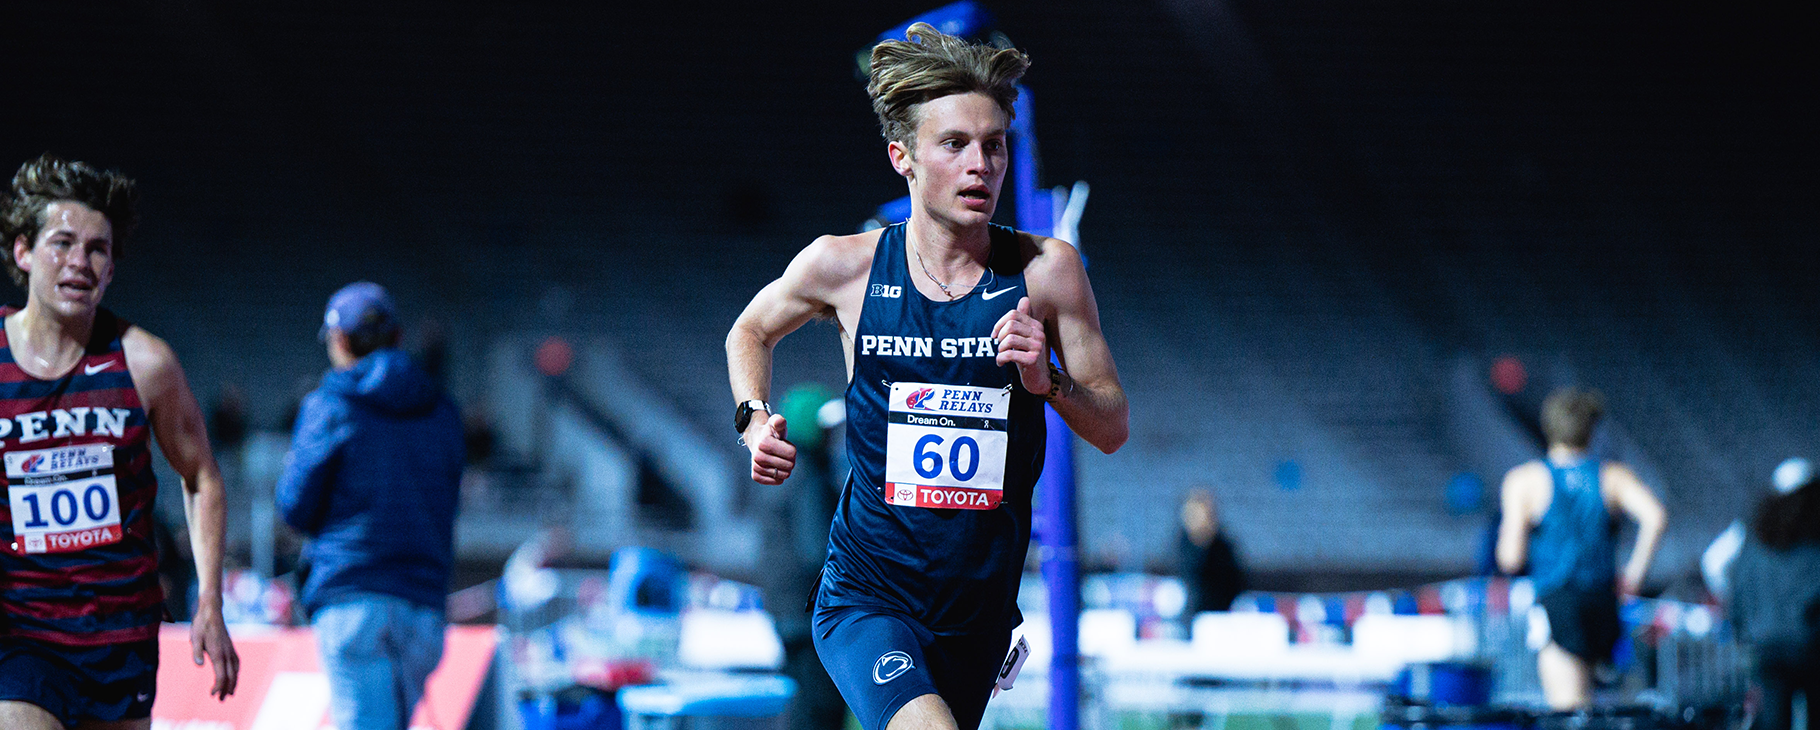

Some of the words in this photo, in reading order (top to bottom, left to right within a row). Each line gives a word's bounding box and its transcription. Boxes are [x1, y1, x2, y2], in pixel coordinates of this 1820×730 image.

[861, 335, 933, 357] PENN
[941, 337, 999, 357] STA
[942, 389, 982, 400] PENN
[939, 401, 993, 413] RELAYS
[907, 414, 938, 425] Dream
[939, 416, 956, 427] On.
[50, 455, 100, 470] RELAYS
[51, 449, 86, 460] PENN
[913, 434, 980, 482] 60
[22, 484, 110, 527] 100
[920, 489, 989, 506] TOYOTA
[48, 527, 113, 549] TOYOTA
